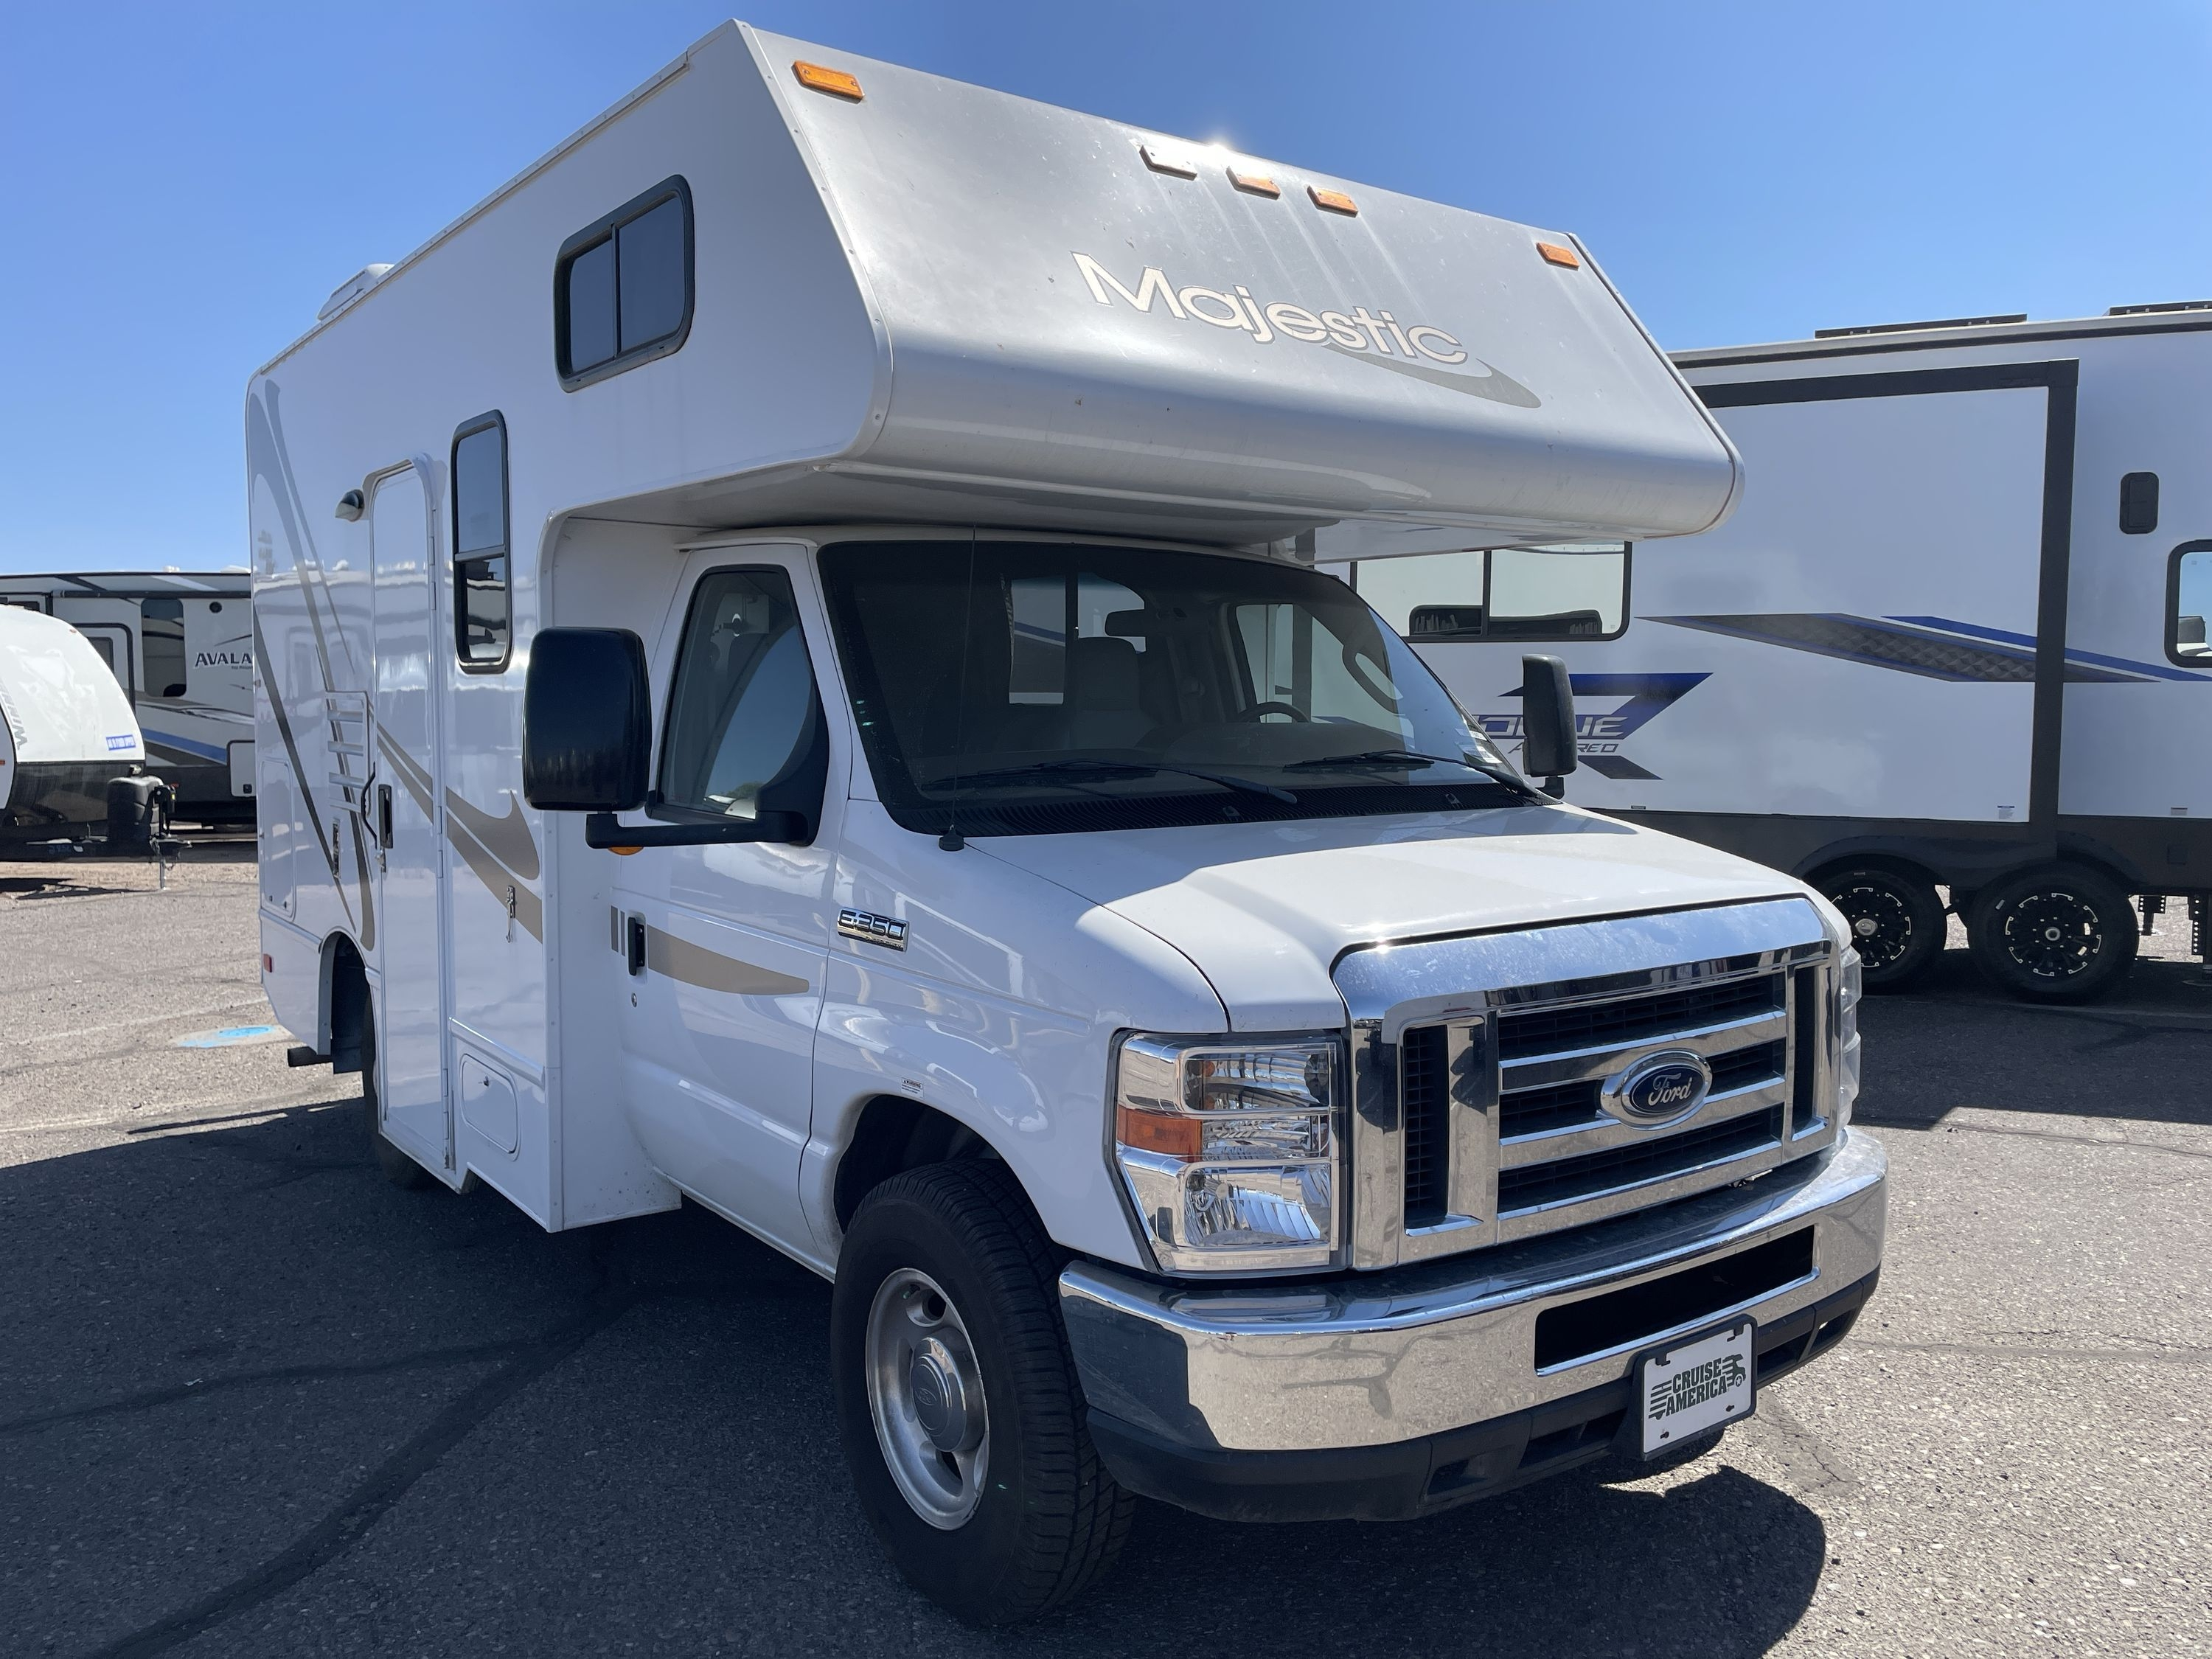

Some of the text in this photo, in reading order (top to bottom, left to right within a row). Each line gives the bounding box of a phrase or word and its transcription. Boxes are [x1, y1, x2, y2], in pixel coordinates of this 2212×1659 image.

[1070, 251, 1469, 365] Majestic
[1648, 1073, 1692, 1106] Ford
[1672, 1357, 1722, 1394] CRUISE
[1666, 1375, 1728, 1416] AMERICA
